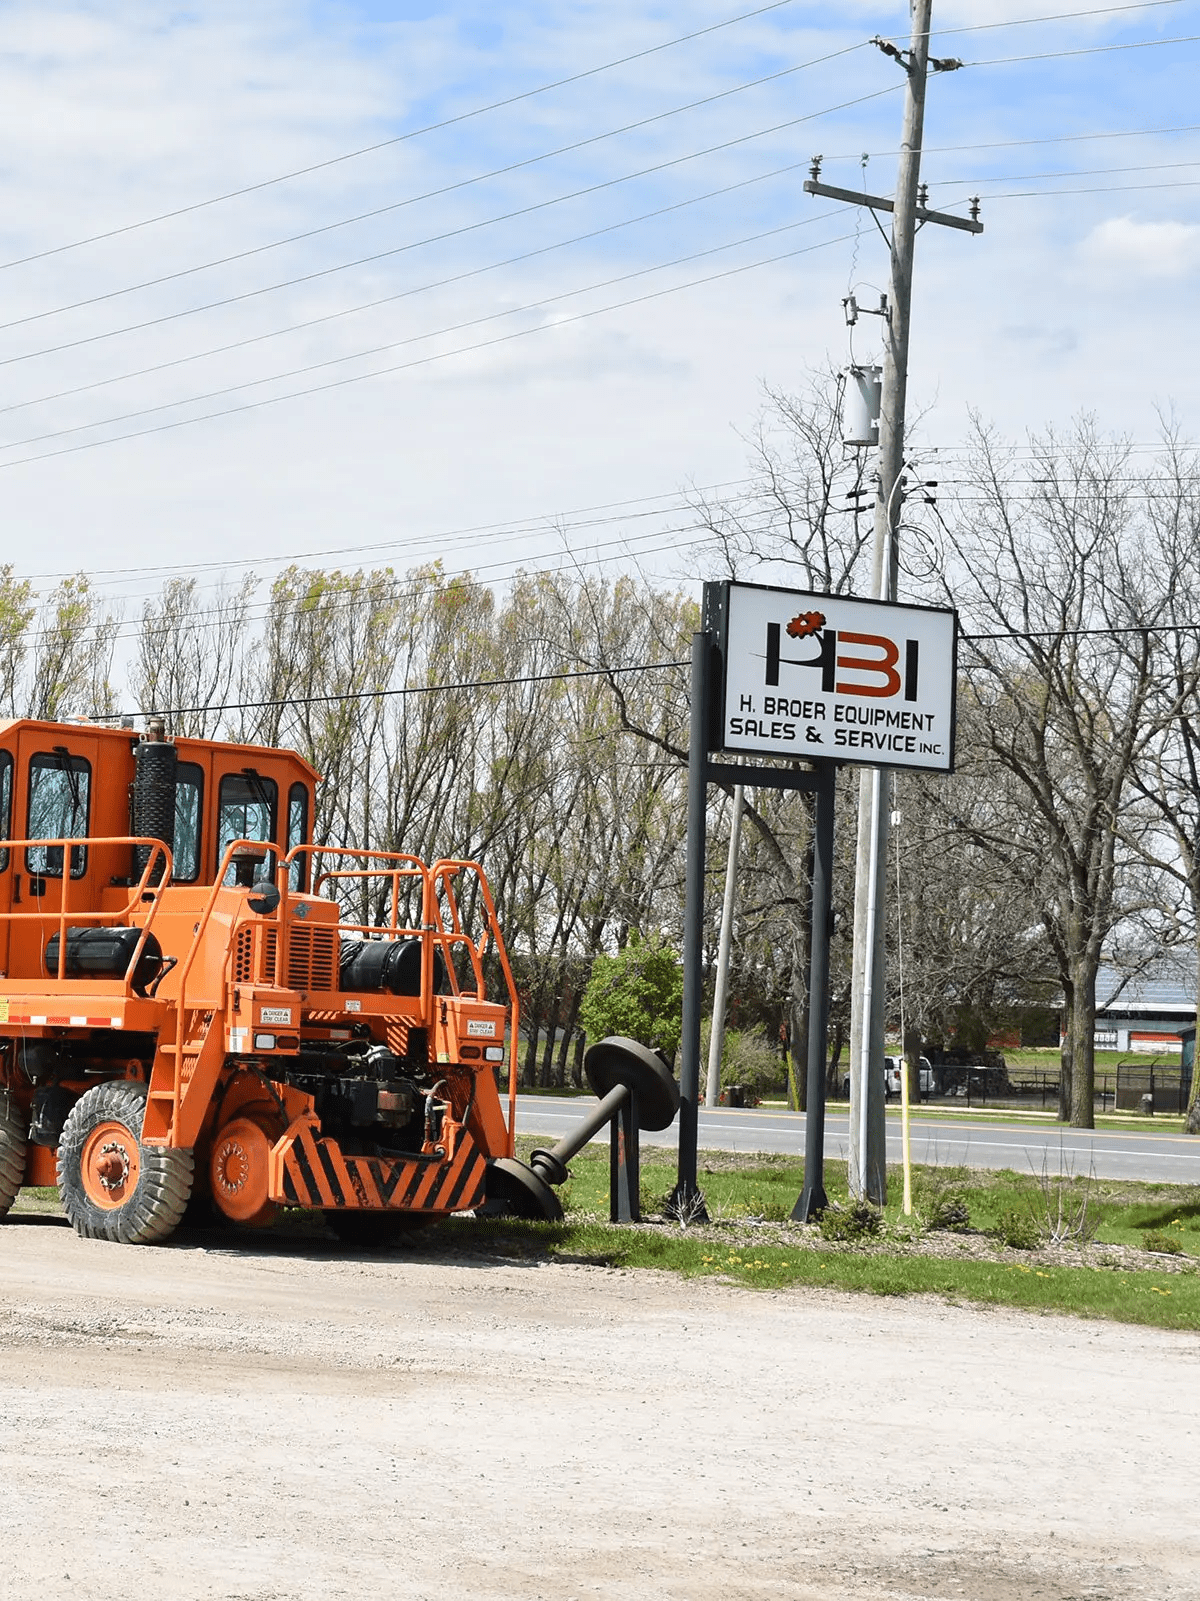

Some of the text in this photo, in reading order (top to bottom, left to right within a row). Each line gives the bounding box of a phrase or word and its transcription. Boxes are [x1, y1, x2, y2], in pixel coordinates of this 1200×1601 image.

[764, 620, 919, 702] HBI
[740, 694, 936, 732] H. BROER EQUIPMENT
[729, 717, 945, 756] SALES & SERVICE INC.
